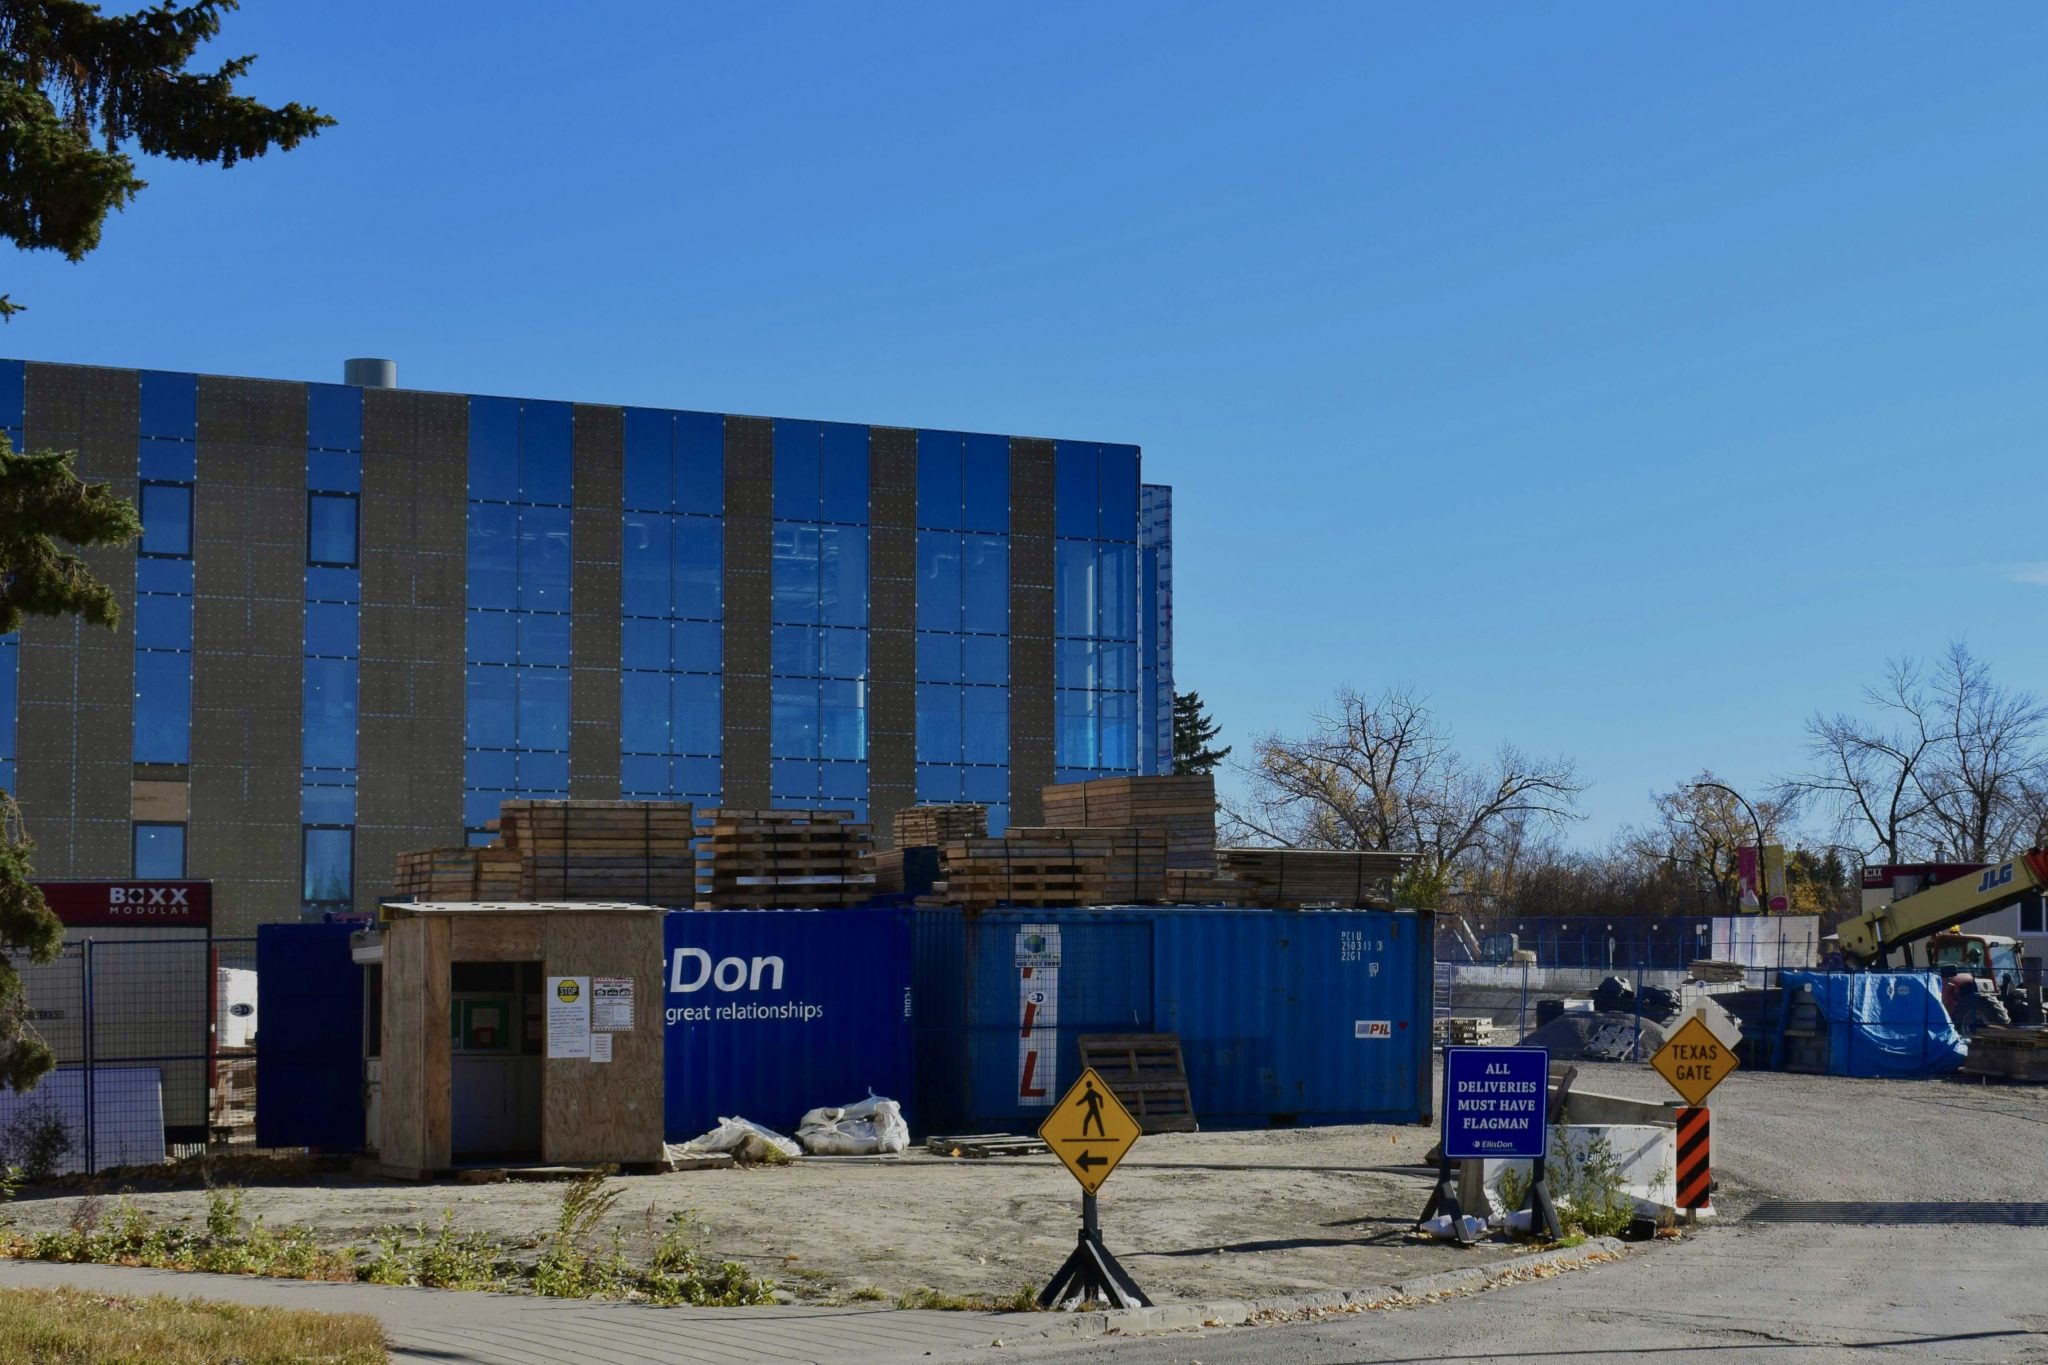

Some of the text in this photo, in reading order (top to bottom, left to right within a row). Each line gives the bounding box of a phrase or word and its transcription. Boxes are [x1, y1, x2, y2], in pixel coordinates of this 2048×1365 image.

[1977, 863, 2013, 893] JLG
[109, 887, 188, 904] BOXX
[1341, 931, 1362, 941] PCIU
[1341, 951, 1361, 961] 22G1
[662, 947, 785, 993] Don
[559, 987, 578, 995] STOP
[665, 1001, 824, 1026] great relationships
[1369, 1024, 1390, 1035] PIL
[1672, 1045, 1718, 1060] TEXAS
[1485, 1063, 1511, 1075] ALL
[1676, 1065, 1712, 1080] GATE
[1457, 1081, 1537, 1093] DELIVERIES
[1457, 1100, 1536, 1111] MUST HAVE
[1463, 1117, 1529, 1129] FLAGMAN
